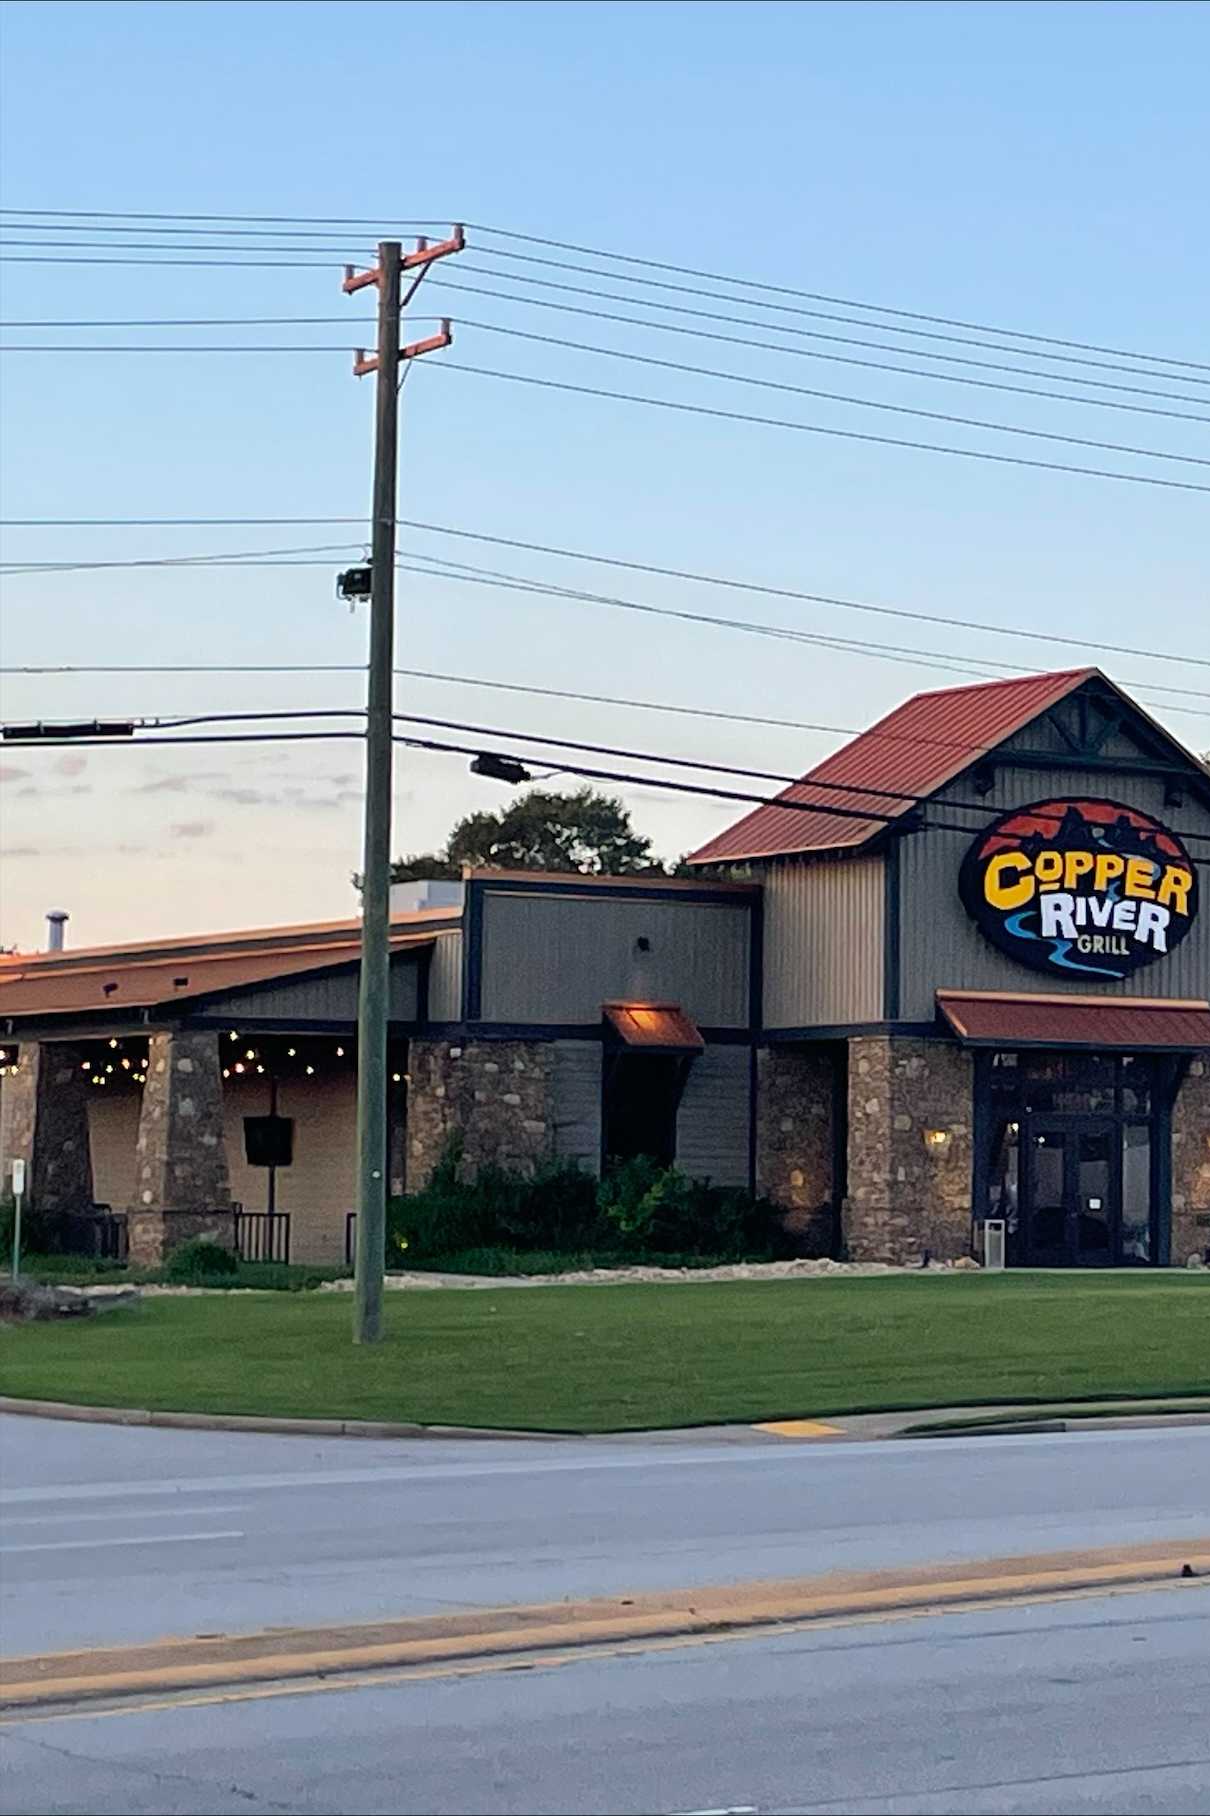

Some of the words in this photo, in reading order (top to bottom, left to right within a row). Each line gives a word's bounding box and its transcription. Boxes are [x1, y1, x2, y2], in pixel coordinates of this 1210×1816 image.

[984, 850, 1193, 917] COPPER
[1040, 892, 1168, 952] RIVER
[1077, 934, 1130, 956] GRILL
